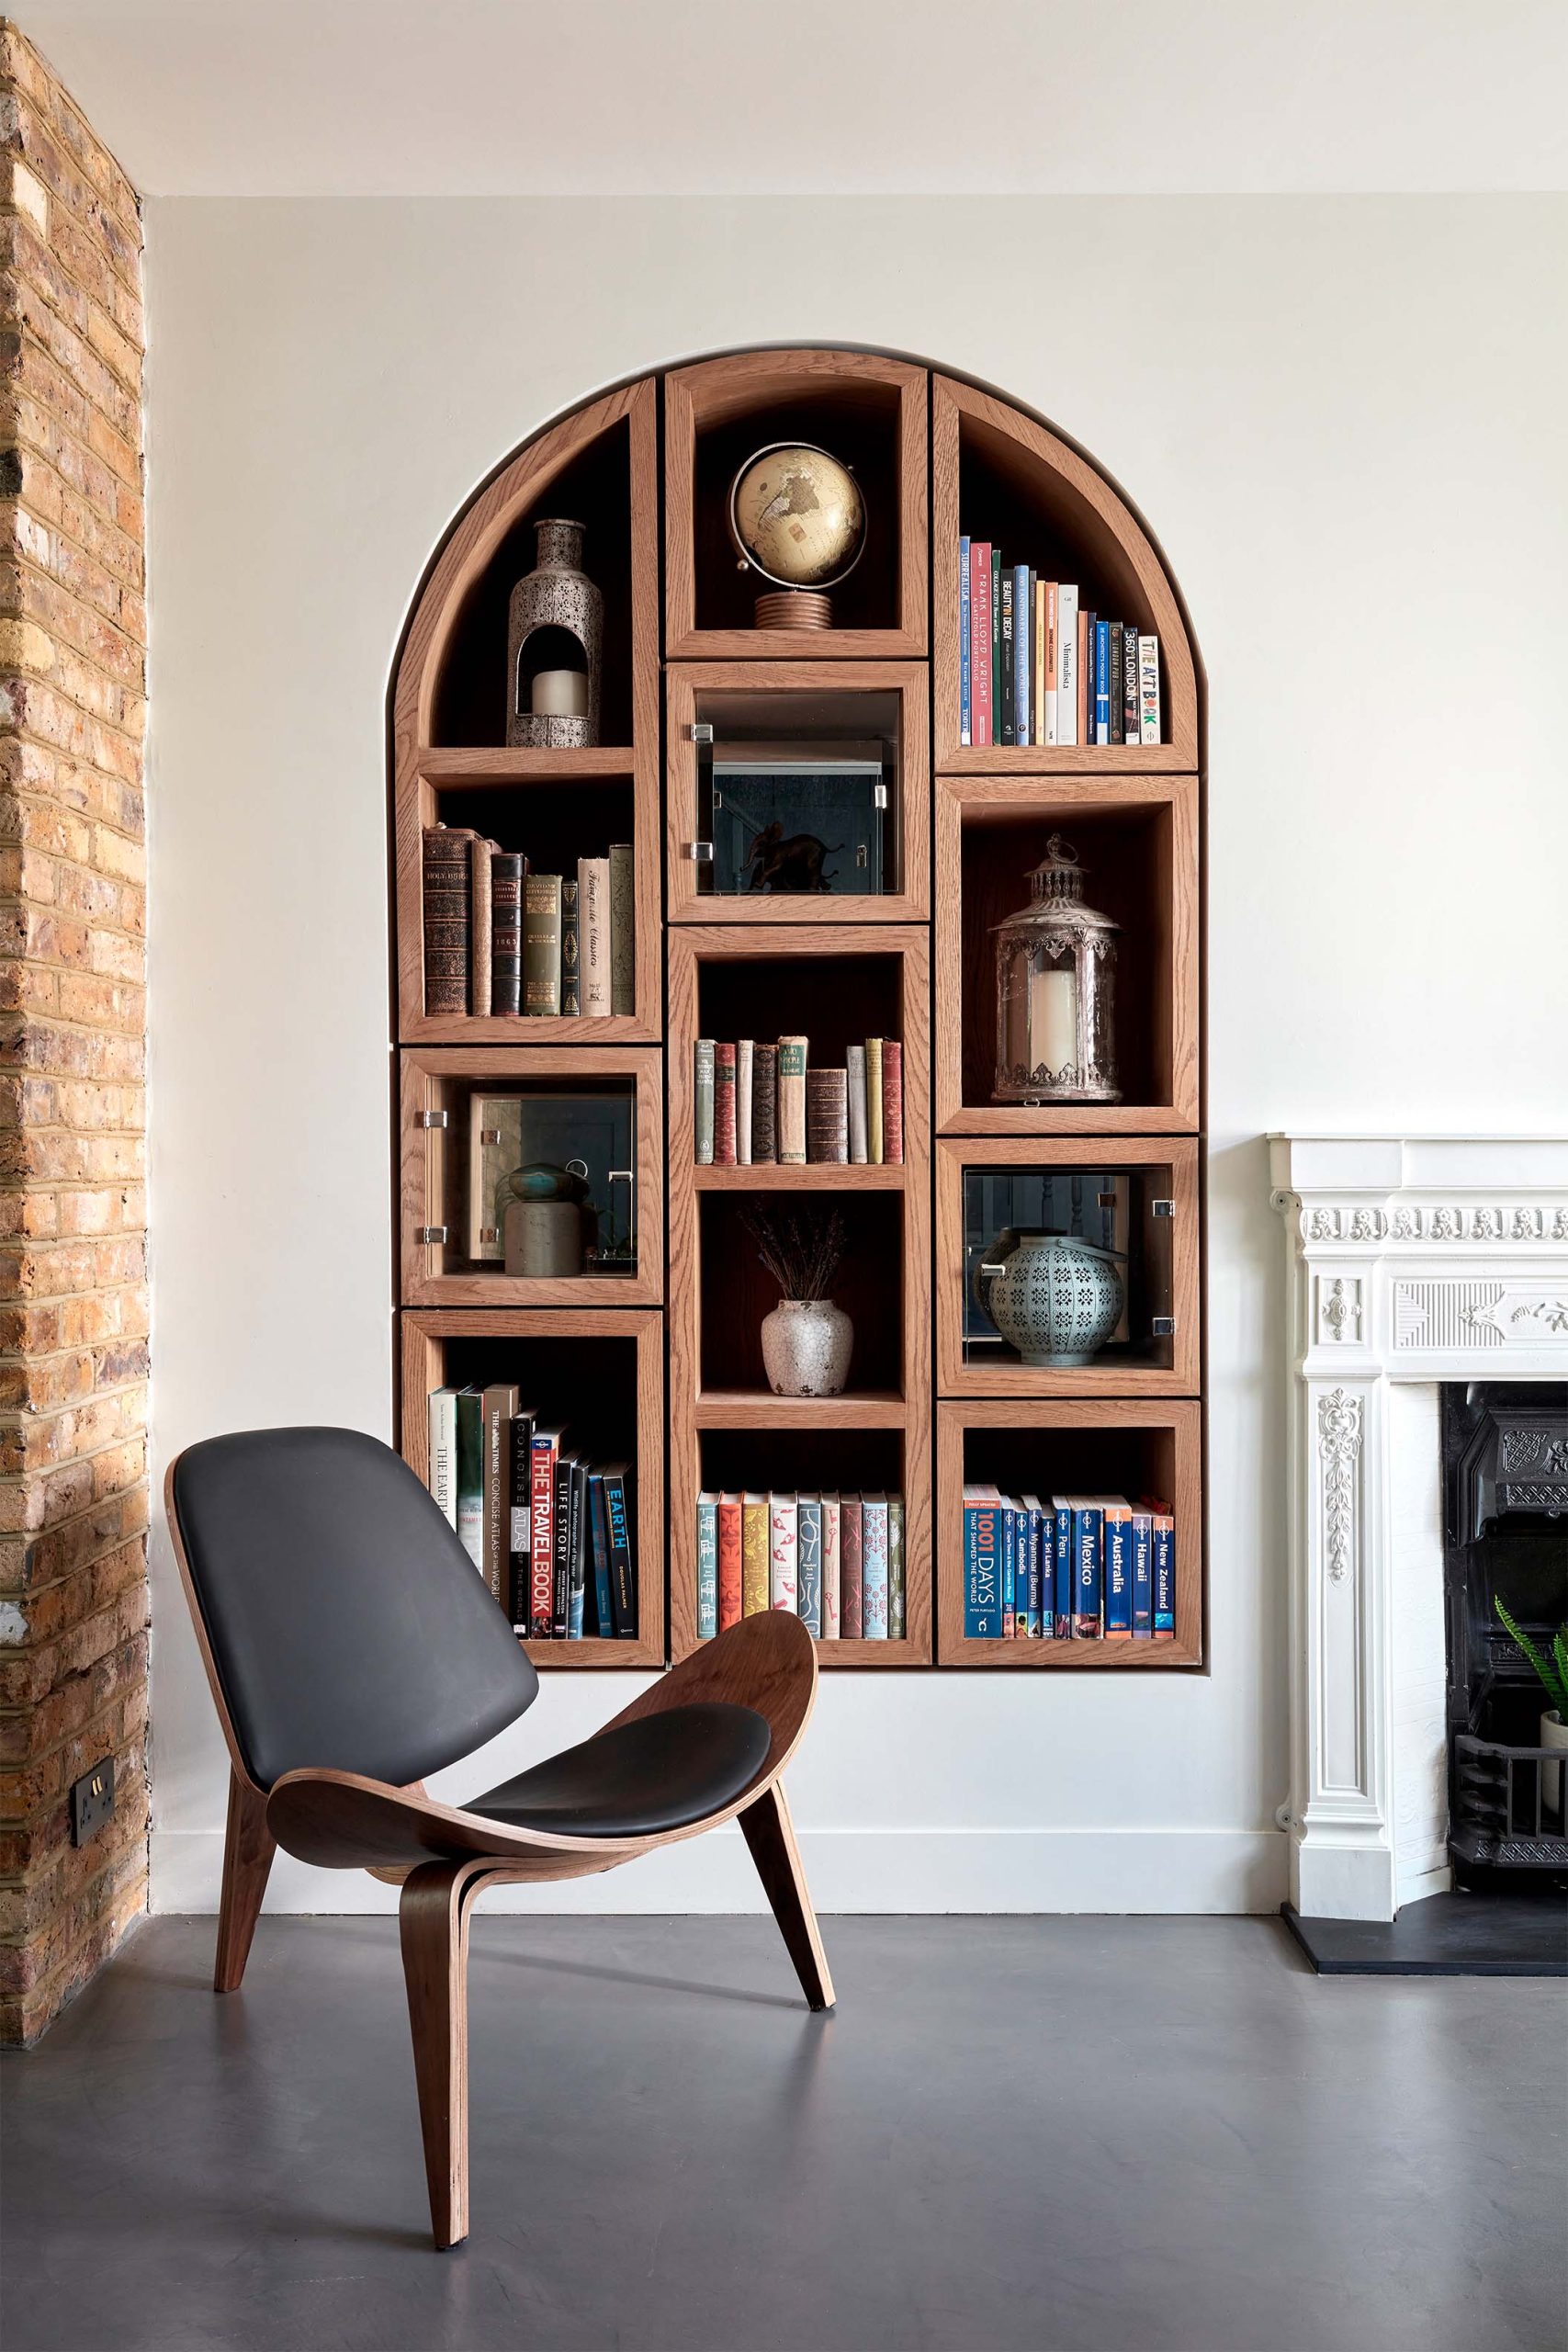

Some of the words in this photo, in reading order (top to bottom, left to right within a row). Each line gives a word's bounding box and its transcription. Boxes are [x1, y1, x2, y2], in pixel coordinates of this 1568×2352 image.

[961, 552, 969, 601] SURREALISM
[1003, 581, 1011, 608] BEAUTY
[1003, 616, 1011, 640] DECAY
[1019, 639, 1025, 648] OF
[1063, 642, 1072, 689] Minimalista
[1143, 641, 1155, 663] THE
[1143, 667, 1156, 689] ART
[1144, 692, 1157, 724] BOOK
[588, 927, 601, 968] Classics
[438, 1446, 447, 1470] THE
[516, 1424, 525, 1503] CONCISE
[535, 1453, 550, 1489] THE
[437, 1475, 447, 1513] EARTH
[491, 1477, 501, 1519] CONCISE
[558, 1483, 568, 1510] LIFE
[491, 1522, 501, 1550] ATLAS
[514, 1509, 526, 1551] ATLAS
[535, 1492, 550, 1558] TRAVEL
[610, 1490, 626, 1548] EARTH
[977, 1512, 994, 1551] 1001
[518, 1554, 524, 1564] OF
[558, 1519, 567, 1561] STORY
[1030, 1532, 1038, 1572] Myanmar
[1059, 1536, 1067, 1557] Peru
[1159, 1544, 1168, 1566] New
[1082, 1535, 1095, 1586] Mexico
[1112, 1534, 1123, 1593] Australia
[1138, 1544, 1146, 1581] Hawaii
[535, 1562, 550, 1612] BOOK
[977, 1557, 994, 1603] DAYS
[1030, 1575, 1038, 1608] (Burma)
[1159, 1568, 1168, 1609] Zealand
